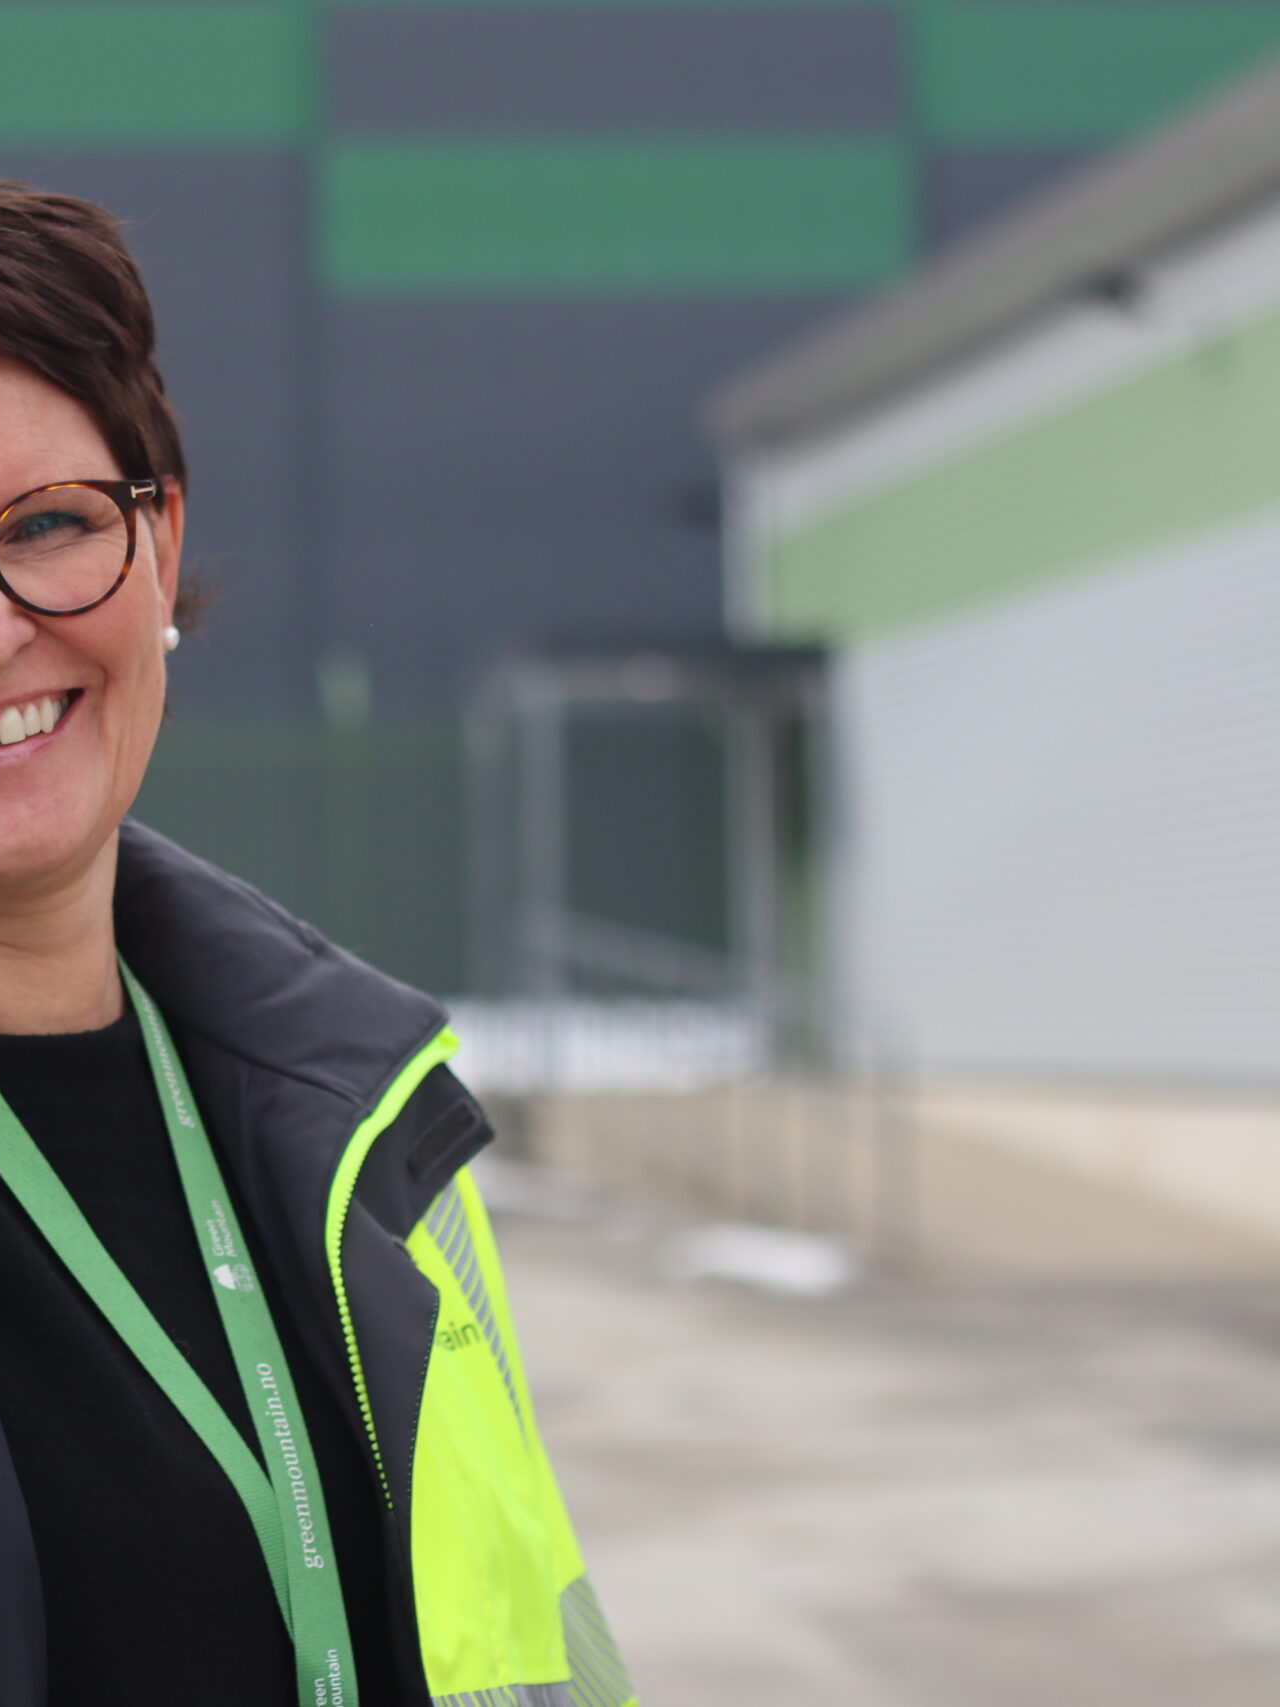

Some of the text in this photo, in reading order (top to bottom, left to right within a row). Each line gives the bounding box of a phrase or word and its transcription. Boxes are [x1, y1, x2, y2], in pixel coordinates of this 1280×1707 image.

[206, 1218, 225, 1257] Green
[211, 1199, 238, 1257] Mountain
[434, 1320, 481, 1352] ain
[256, 1362, 324, 1569] greenmountain.no
[313, 1677, 328, 1707] een
[324, 1648, 344, 1707] ountain
